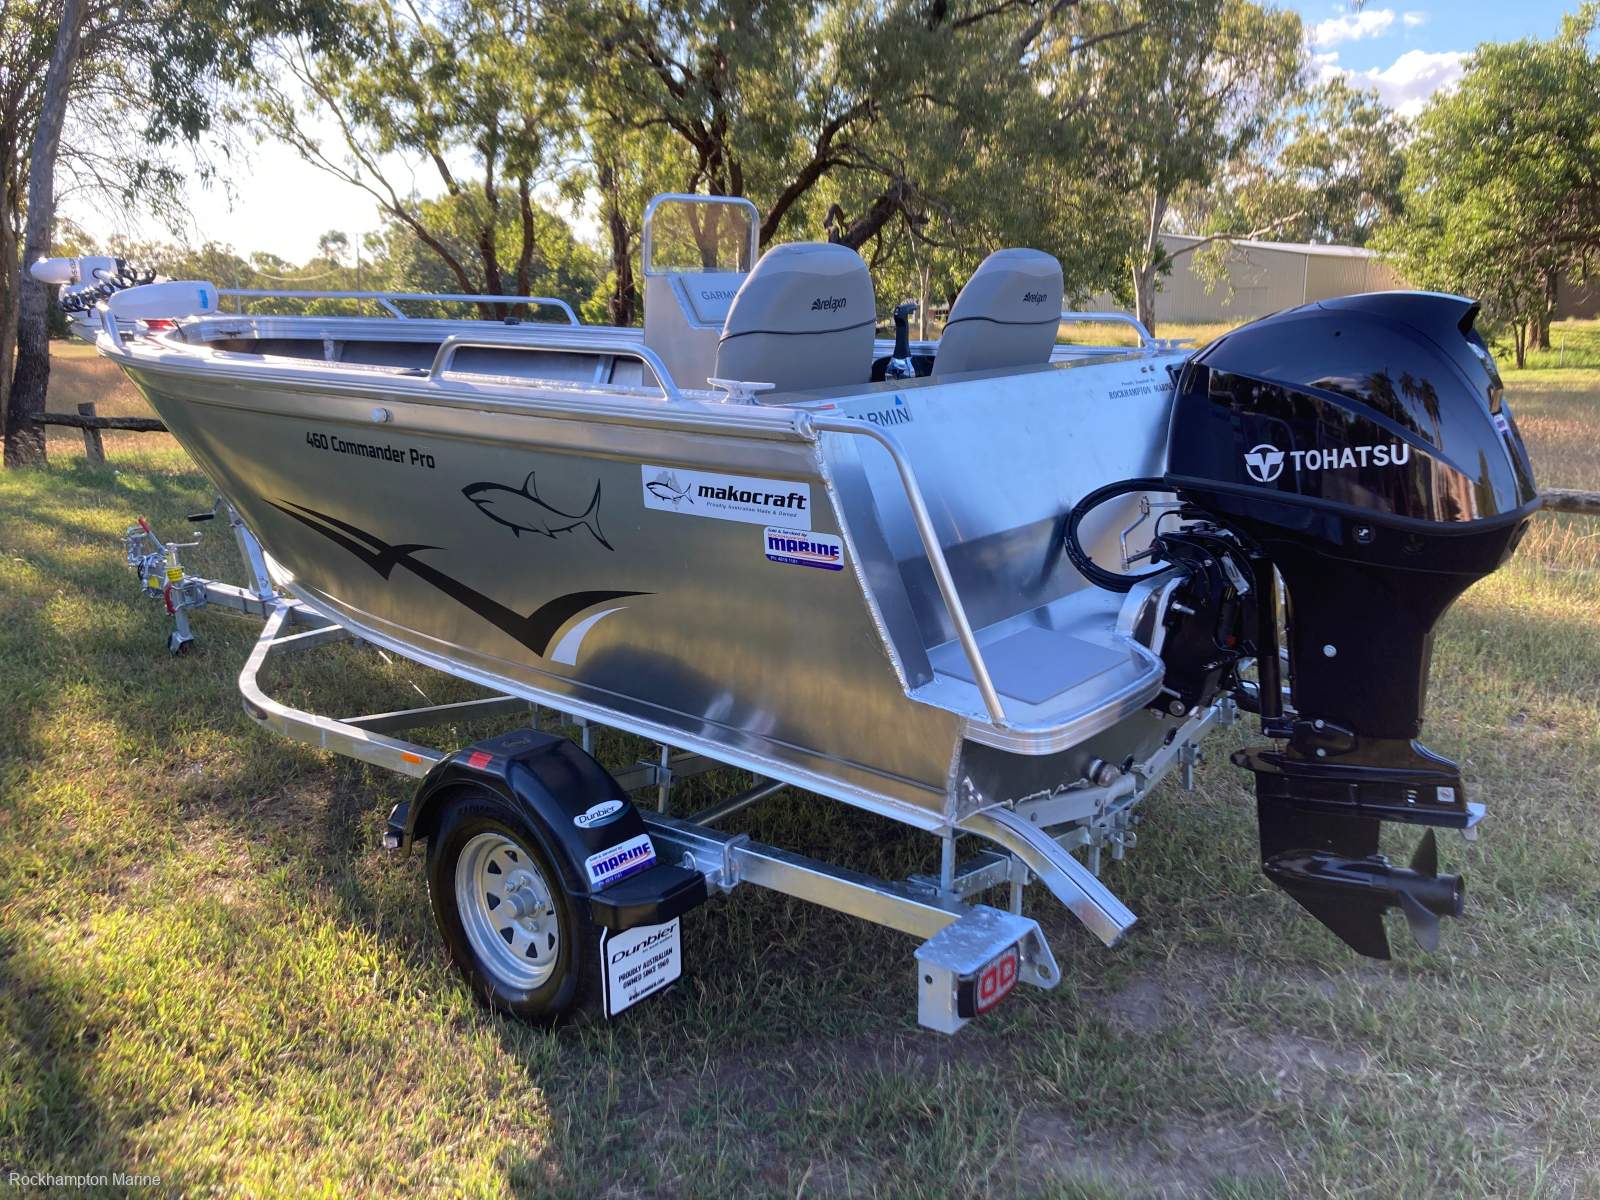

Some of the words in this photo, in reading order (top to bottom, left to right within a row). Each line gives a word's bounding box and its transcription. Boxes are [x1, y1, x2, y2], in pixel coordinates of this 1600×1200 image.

[701, 289, 737, 301] GARMI
[1108, 386, 1152, 400] ROCKHAMPTON
[847, 407, 910, 427] RMIN
[306, 431, 329, 450] 460
[330, 436, 406, 463] Commander
[409, 448, 436, 469] Pro
[1290, 443, 1409, 471] TOHATSU
[698, 484, 807, 510] makocraft
[768, 537, 840, 557] MARINE
[578, 806, 615, 824] Dunbier
[591, 842, 652, 878] MARINE
[612, 923, 677, 965] Dunbier
[618, 963, 642, 983] PROUDLY
[642, 947, 673, 970] AUSTRALIAN
